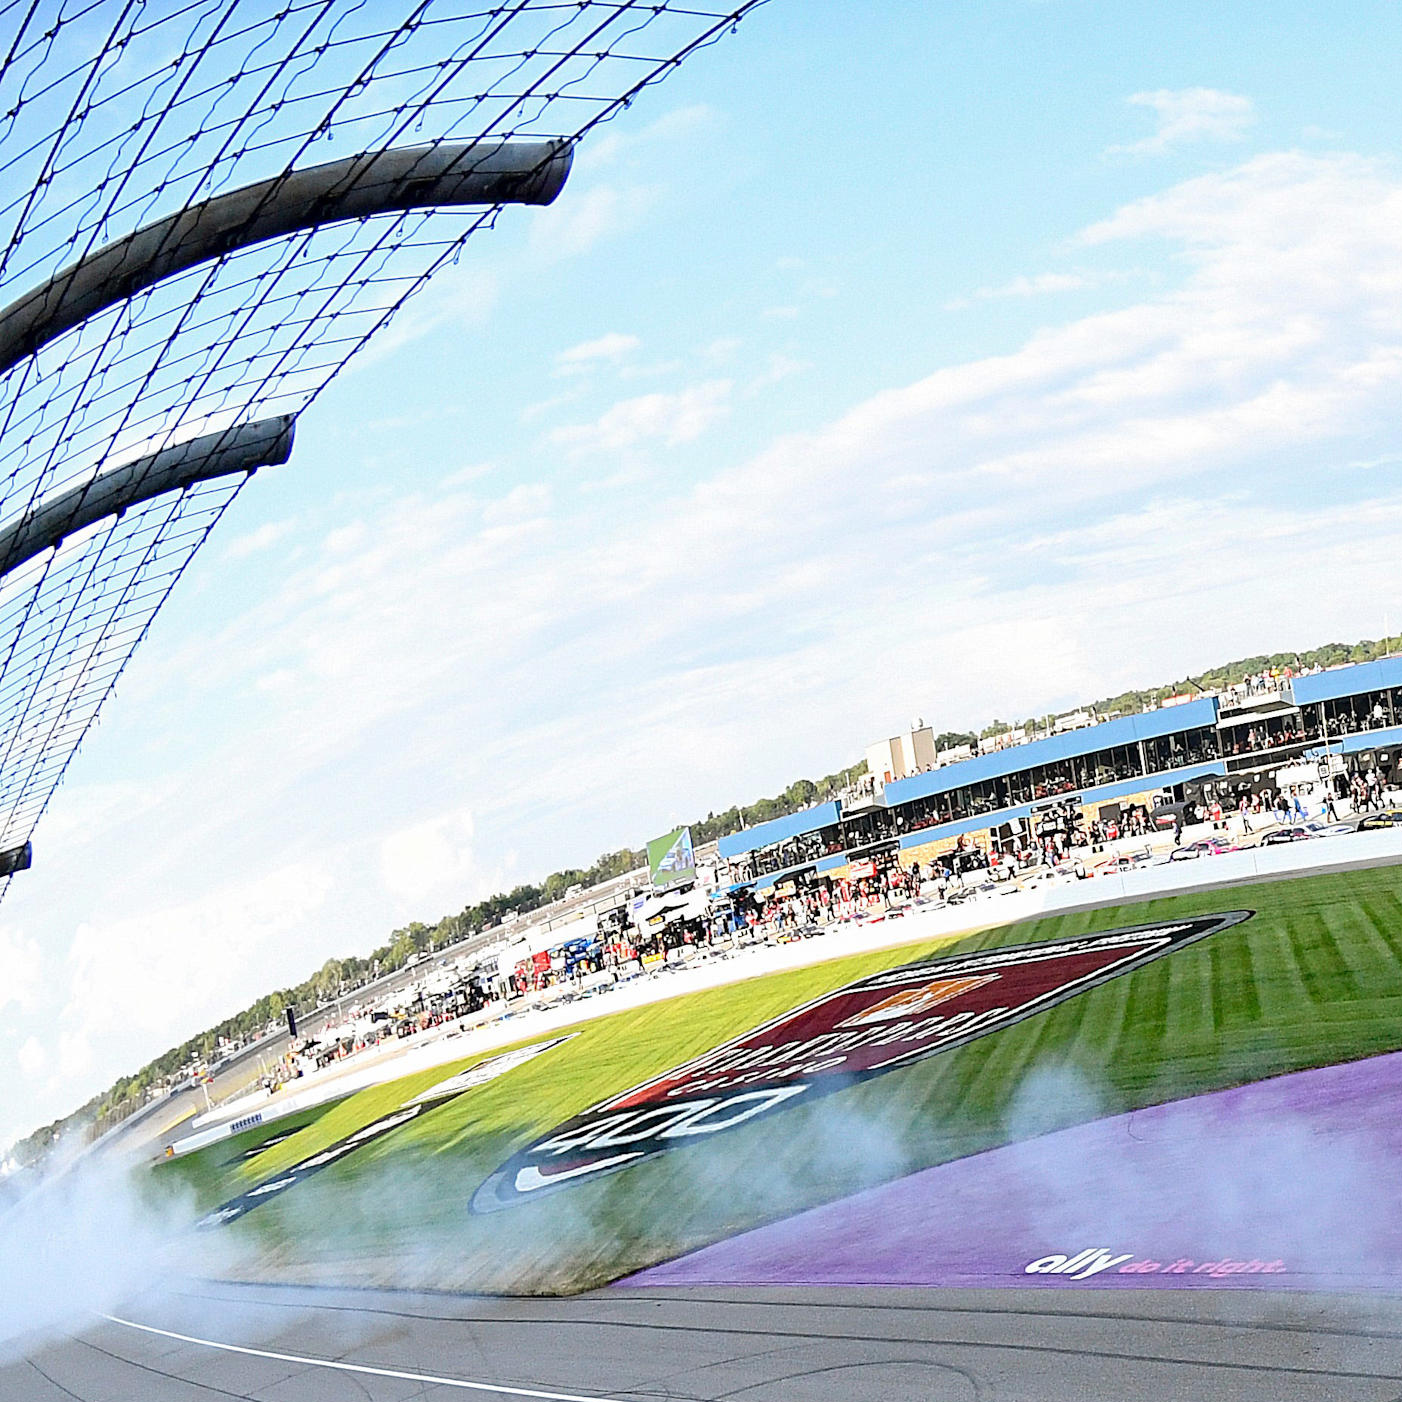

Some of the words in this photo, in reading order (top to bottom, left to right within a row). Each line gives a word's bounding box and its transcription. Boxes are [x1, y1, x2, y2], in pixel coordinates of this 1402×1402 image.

[531, 1083, 811, 1154] 400
[1025, 1248, 1133, 1280] ally
[1119, 1258, 1152, 1274] do
[1161, 1258, 1195, 1274] it
[1192, 1257, 1288, 1278] right.
